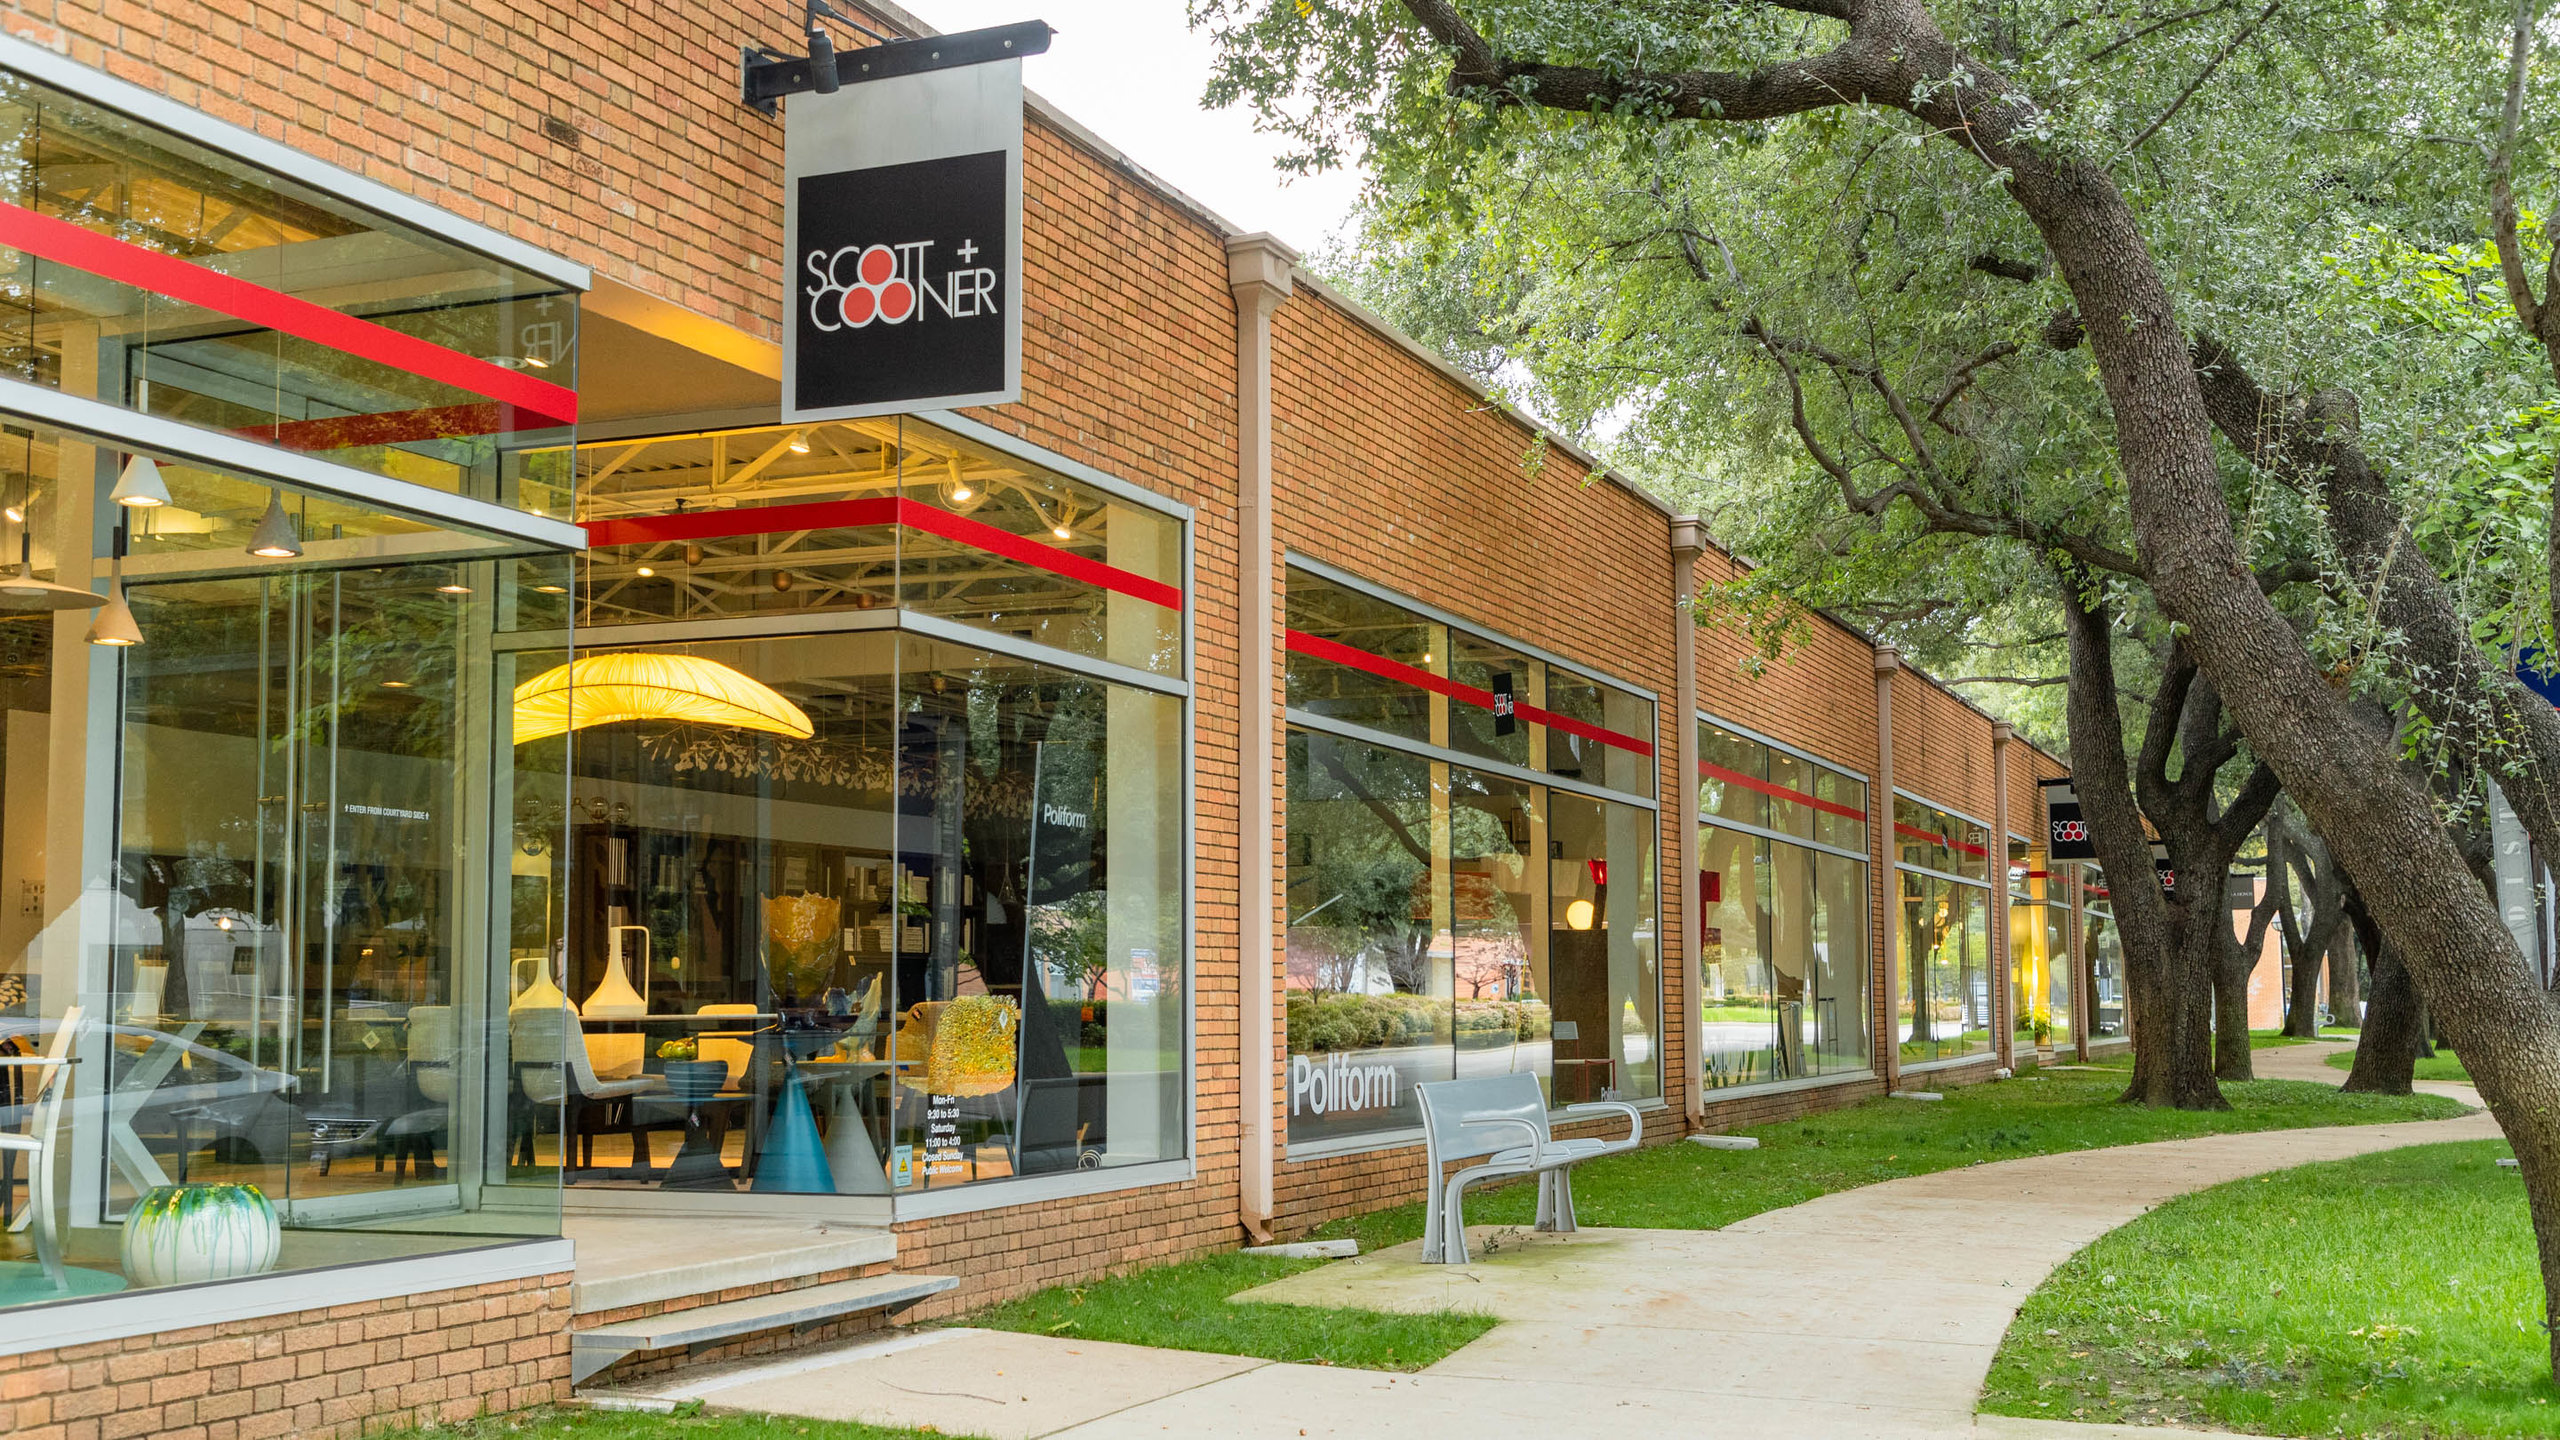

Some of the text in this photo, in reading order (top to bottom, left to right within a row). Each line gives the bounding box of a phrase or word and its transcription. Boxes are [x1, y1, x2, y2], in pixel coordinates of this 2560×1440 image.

[806, 240, 935, 297] SCOTT
[810, 267, 998, 332] COONER
[349, 805, 425, 819] ENTER FROM COURTYARD SIDE
[1043, 803, 1087, 828] Poliform
[2498, 785, 2528, 921] DIST
[1292, 1052, 1397, 1117] Poliform
[933, 1095, 954, 1104] Mon-Fri
[928, 1108, 959, 1119] 9:30 to 5:30
[931, 1123, 955, 1134] Saturday
[926, 1135, 961, 1148] 11:00 to 4:00
[921, 1151, 964, 1162] Closed Sunday
[921, 1164, 963, 1175] Public Welcome
